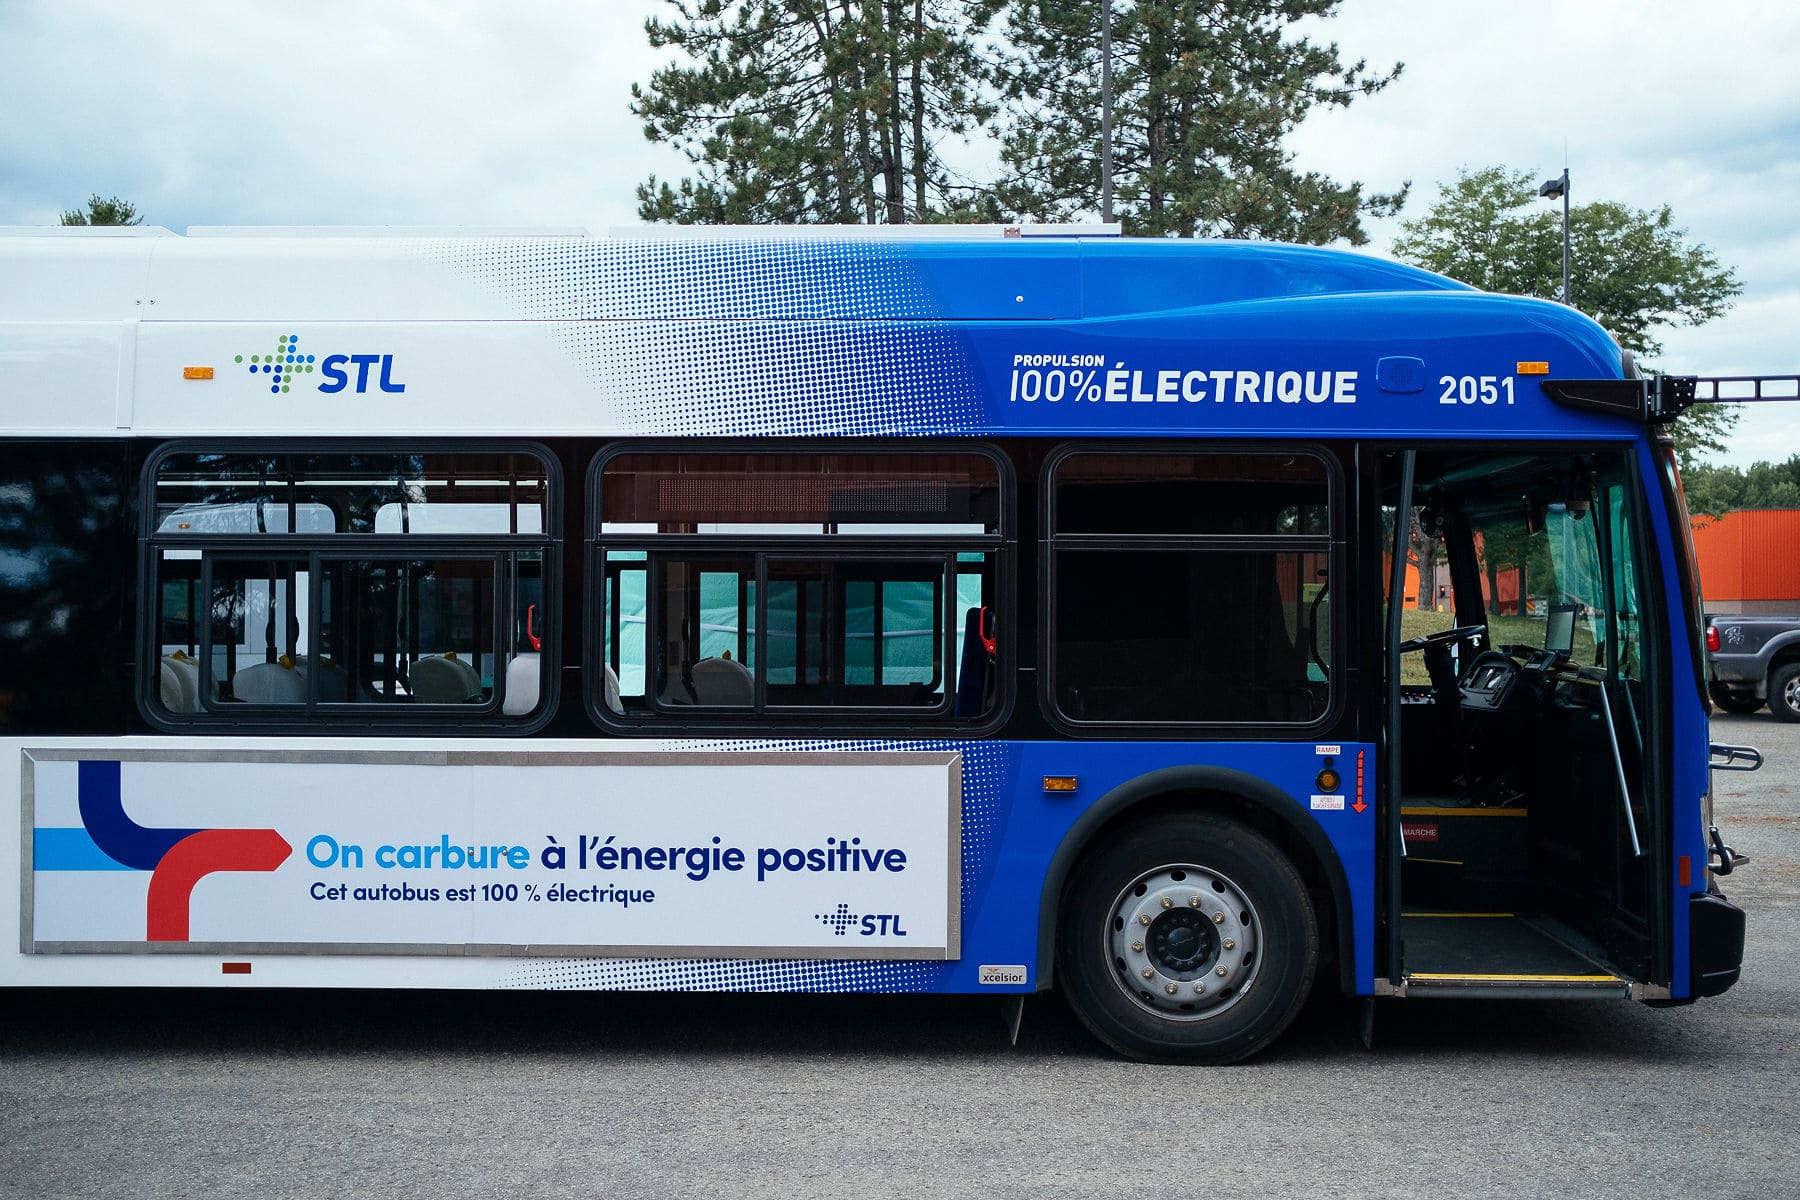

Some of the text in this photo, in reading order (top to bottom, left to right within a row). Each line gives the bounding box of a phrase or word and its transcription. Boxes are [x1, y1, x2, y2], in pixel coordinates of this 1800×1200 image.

[317, 354, 406, 394] STL
[1013, 354, 1105, 367] PROPULSION
[1010, 361, 1358, 404] 100% ÉLECTRIQUE
[1439, 375, 1516, 405] 2051
[1403, 828, 1437, 837] MARCHE
[306, 834, 907, 882] On carbure à l'énergie positive
[309, 881, 656, 909] Cet autobus est 100 % électrique
[859, 914, 907, 937] STL
[983, 972, 1023, 982] xcelsior
